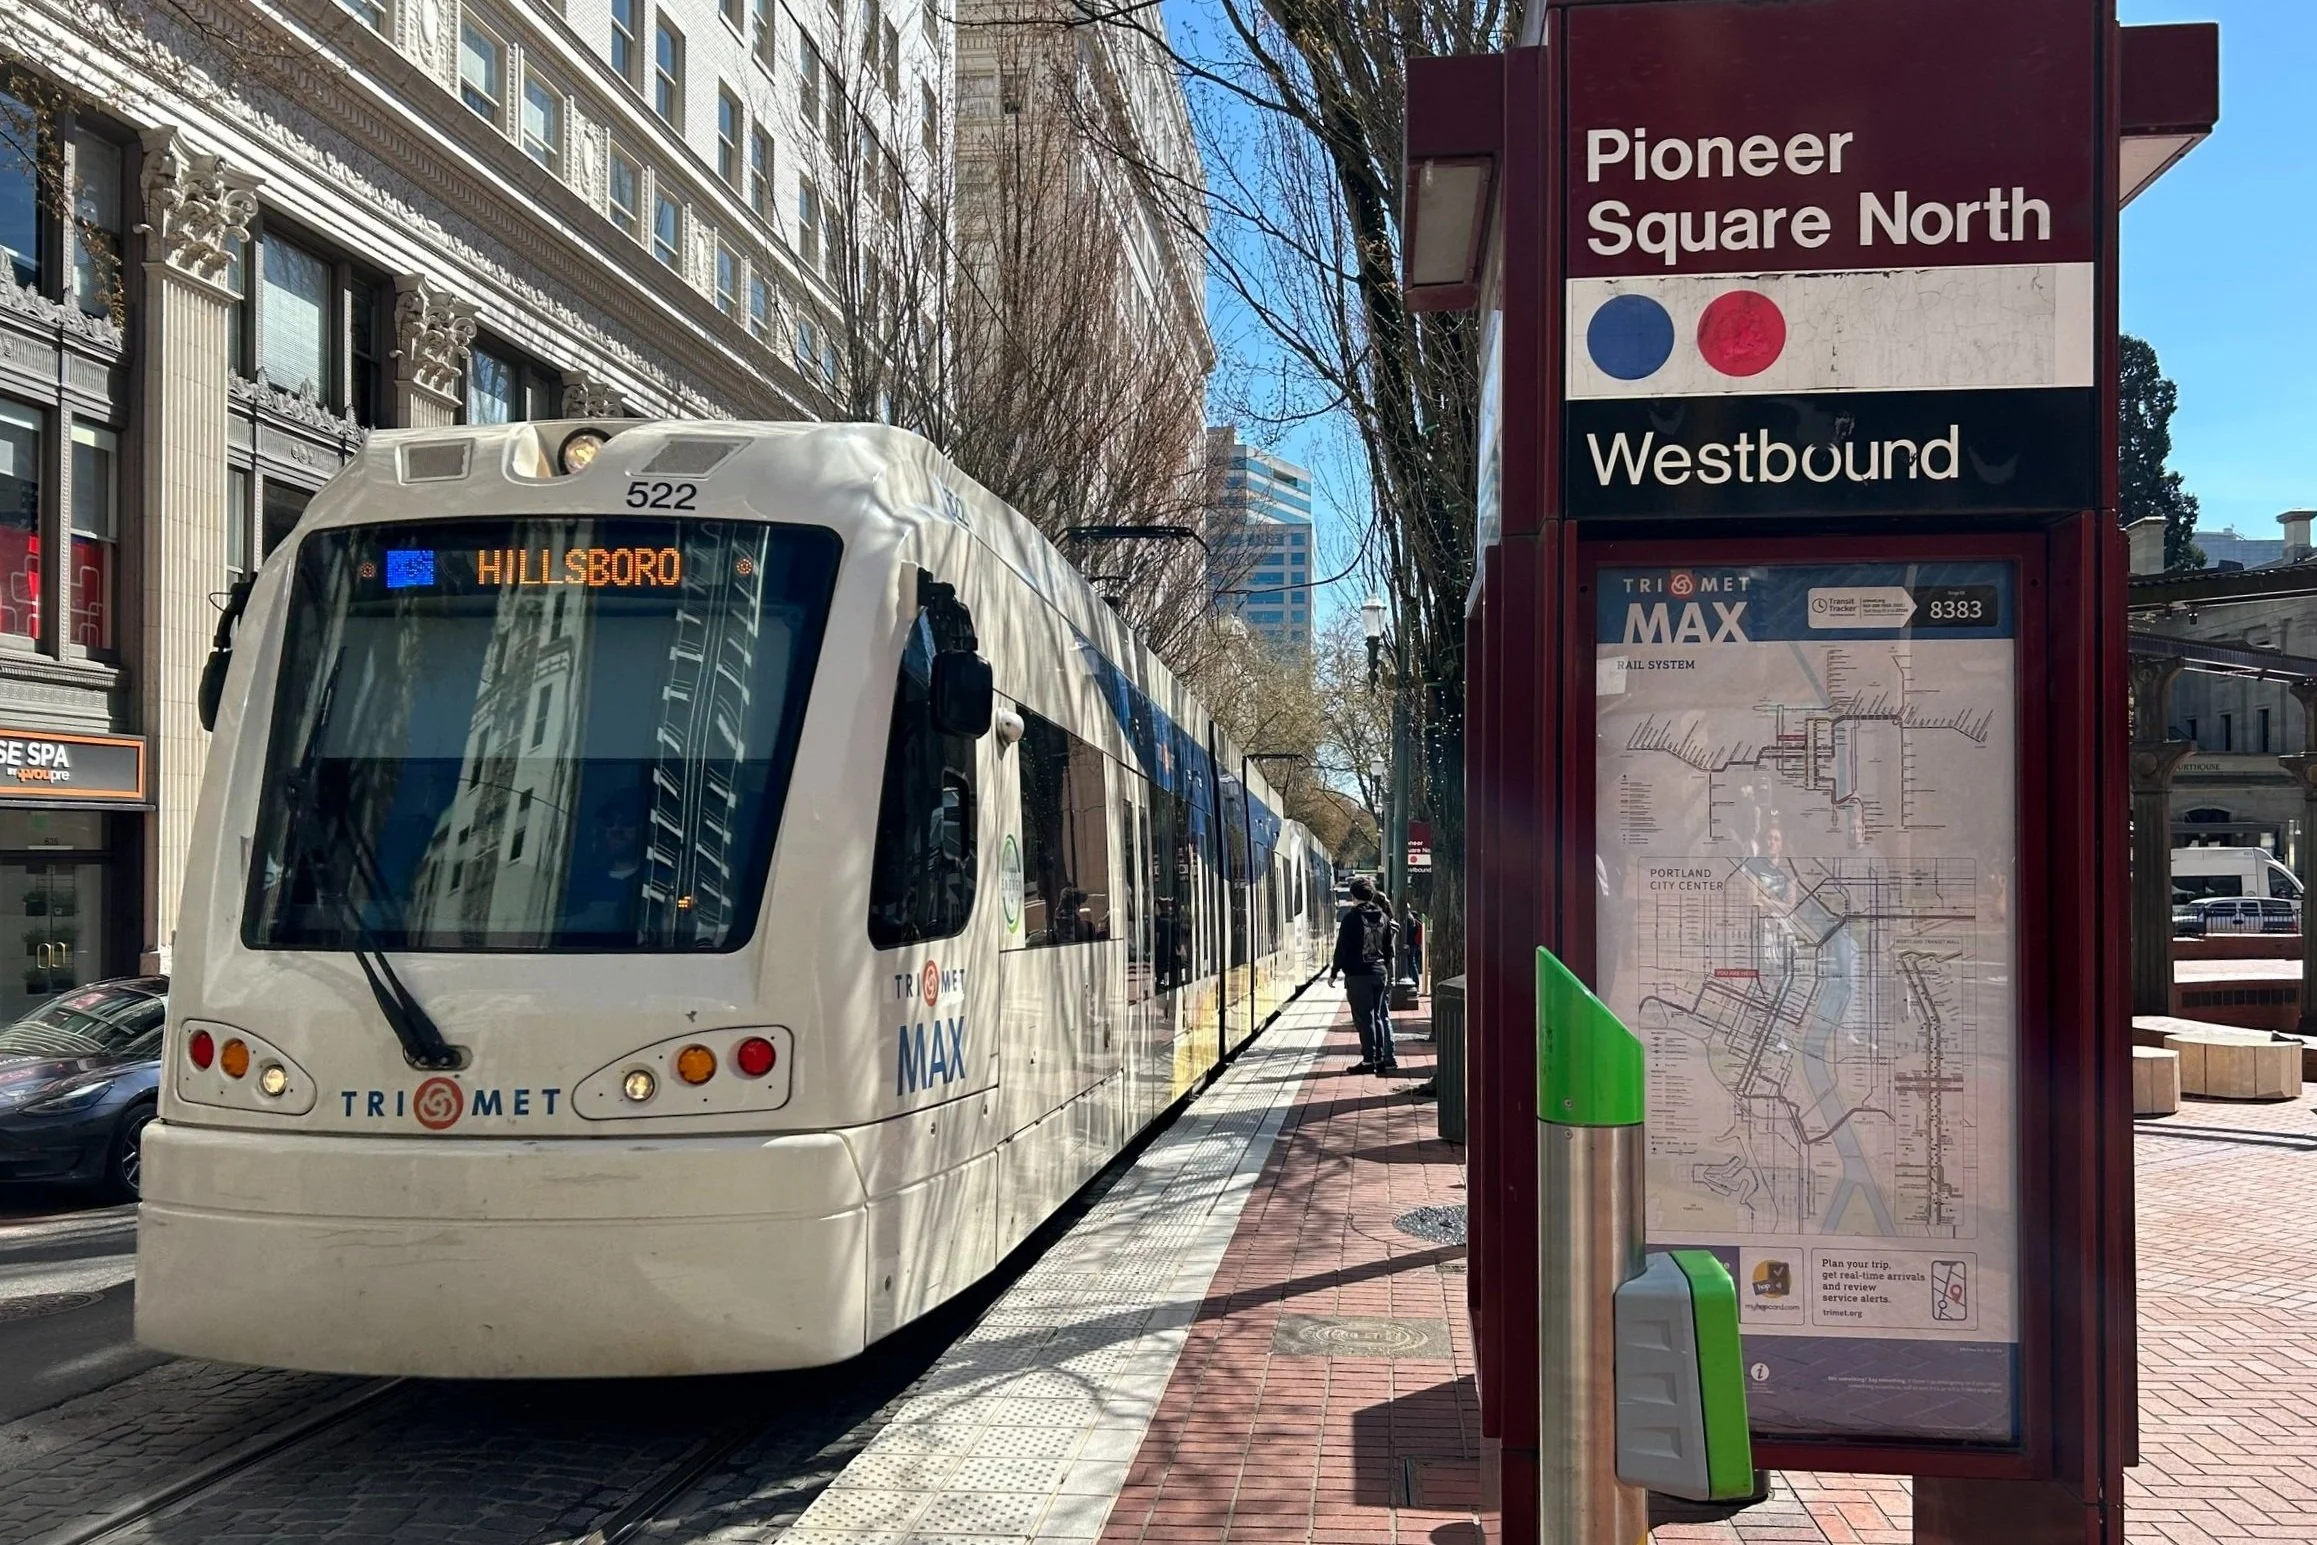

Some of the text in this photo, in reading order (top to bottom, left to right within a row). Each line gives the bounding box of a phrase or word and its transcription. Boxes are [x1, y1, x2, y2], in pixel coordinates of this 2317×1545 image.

[1587, 127, 1853, 182] Pioneer
[1587, 187, 2051, 265] Square North
[1586, 424, 1960, 487] Westbound
[625, 481, 697, 511] 522
[476, 547, 682, 587] HILLSBORO
[1623, 576, 1750, 593] TRI MET
[1930, 600, 1982, 619] 8383
[1623, 601, 1750, 644] MAX
[1617, 659, 1696, 670] RAIL SYSTEM
[27, 741, 70, 768] SPA
[1650, 868, 1712, 878] PORTLAND
[1650, 881, 1724, 890] CITY CENTER
[894, 968, 965, 999] TRI MET
[897, 1016, 966, 1096] MAX
[341, 1088, 561, 1117] TRI MET
[1822, 1259, 1892, 1271] Plan your trip,
[1822, 1271, 1926, 1281] get real-time arrivals
[1822, 1282, 1877, 1291] and review
[1822, 1294, 1892, 1303] service alerts.
[1823, 1309, 1863, 1319] trimet.org
